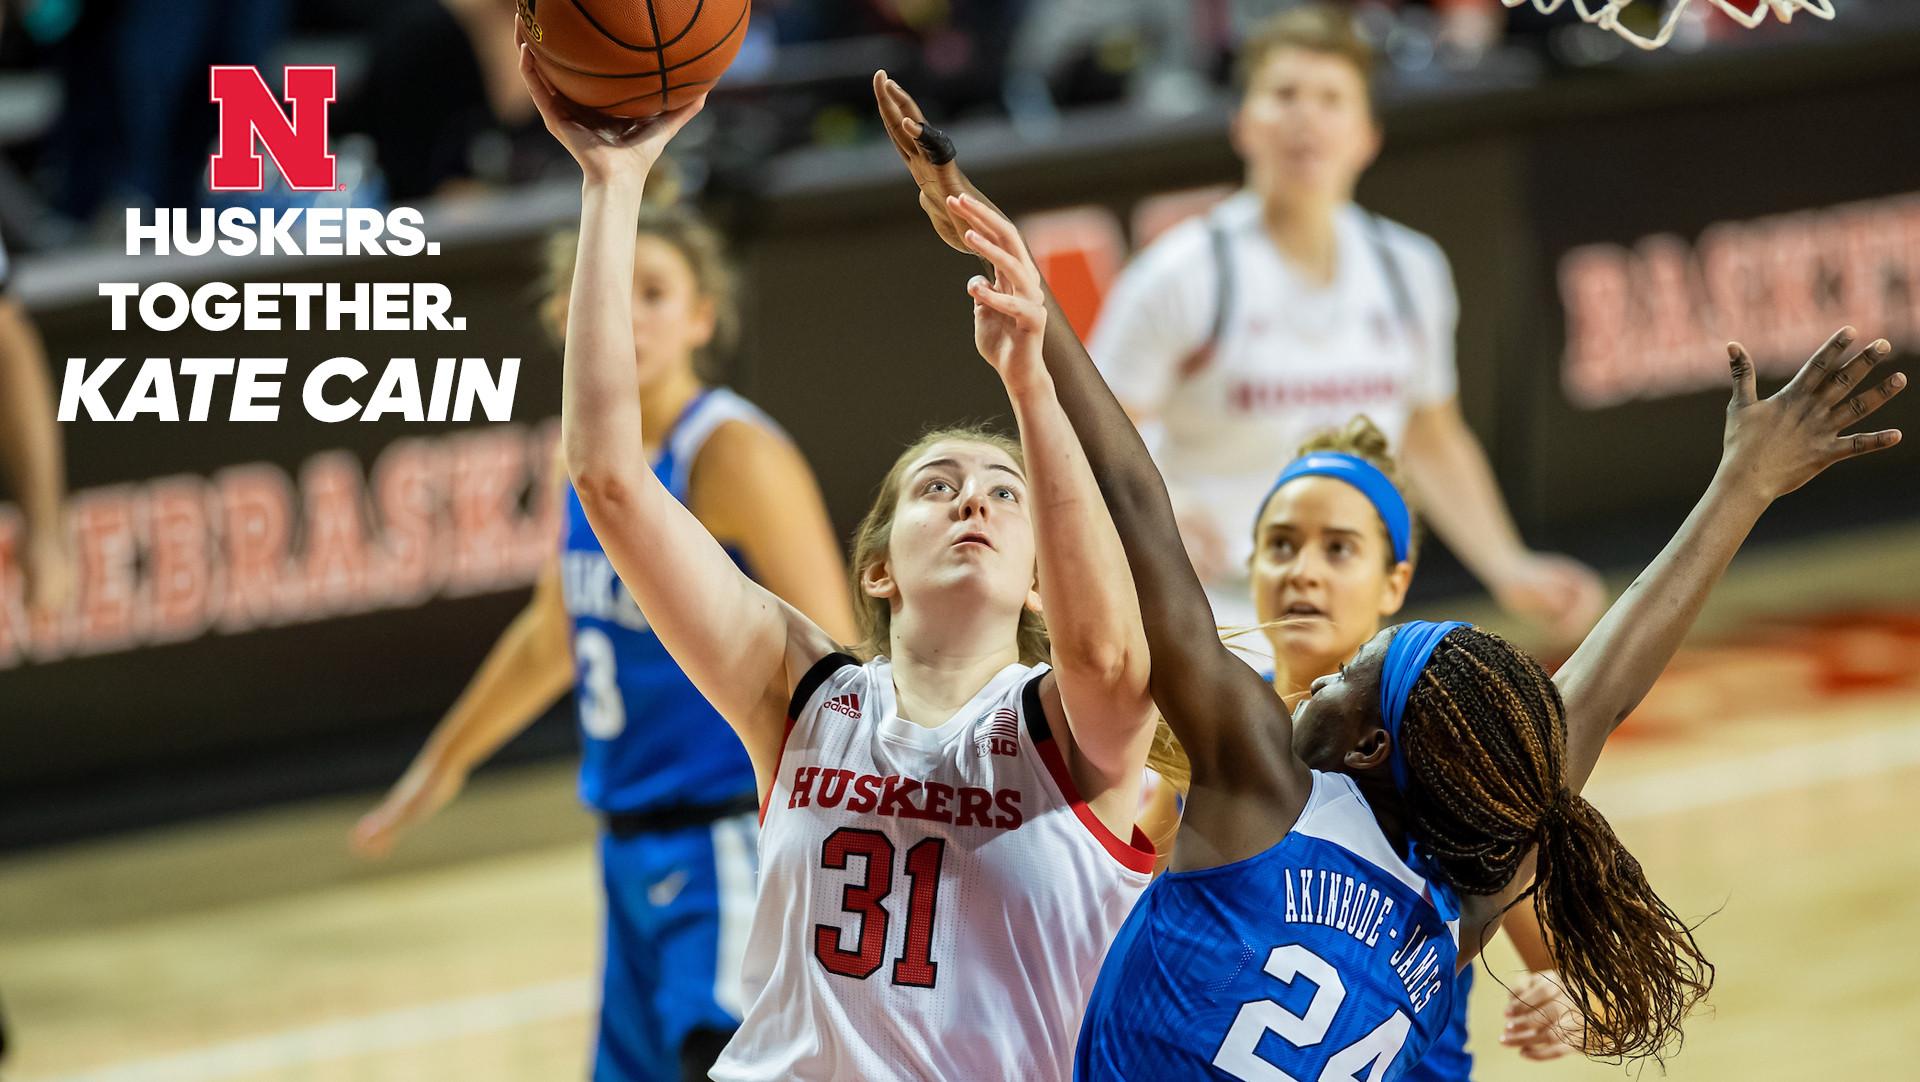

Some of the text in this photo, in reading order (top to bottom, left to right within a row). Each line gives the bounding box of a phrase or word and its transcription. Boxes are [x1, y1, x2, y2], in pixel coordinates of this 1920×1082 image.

[0, 415, 562, 668] EBRASK
[823, 701, 862, 719] adidas
[788, 767, 1023, 830] HUSKERS
[814, 827, 946, 989] 31
